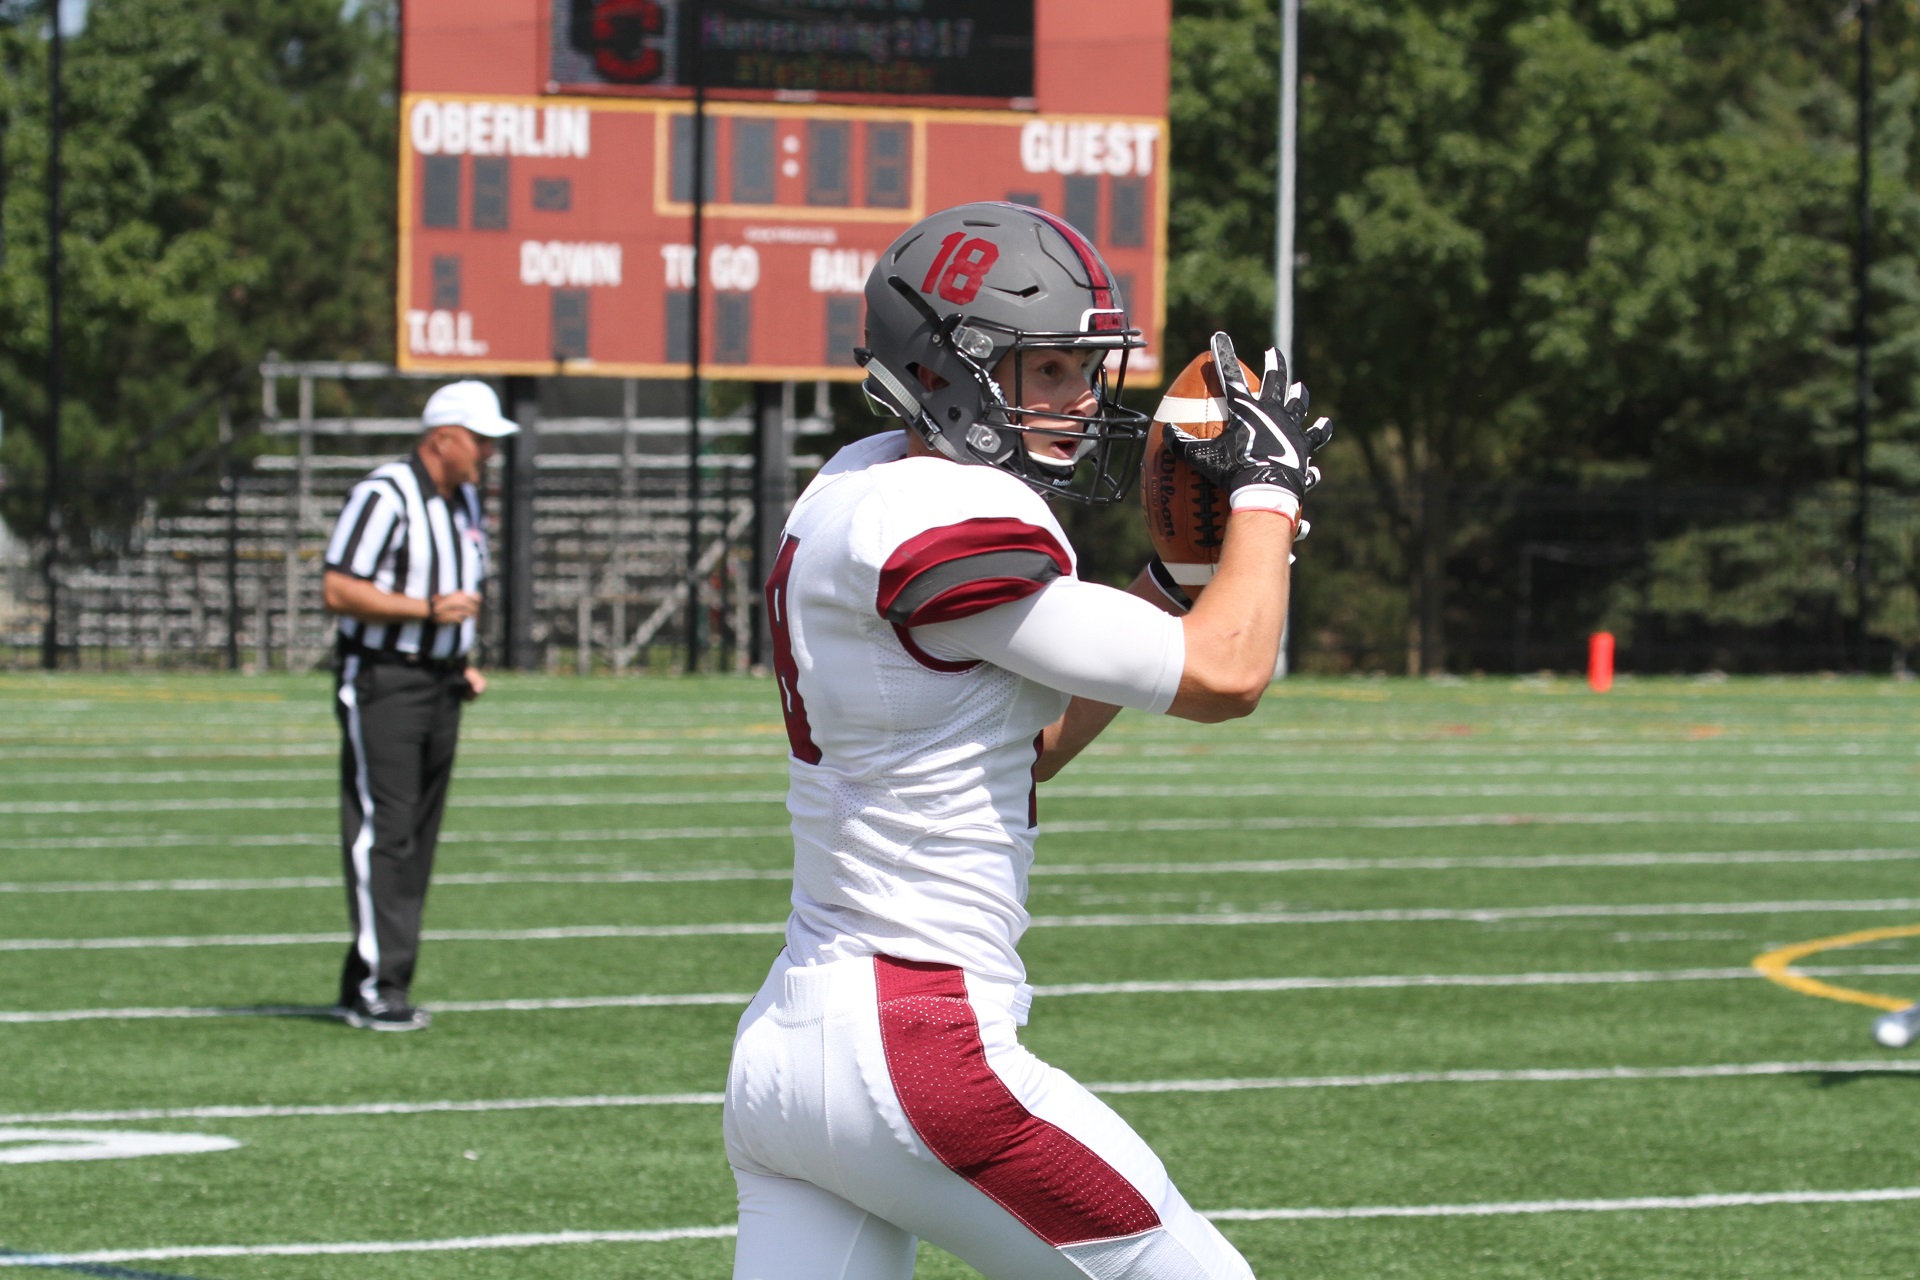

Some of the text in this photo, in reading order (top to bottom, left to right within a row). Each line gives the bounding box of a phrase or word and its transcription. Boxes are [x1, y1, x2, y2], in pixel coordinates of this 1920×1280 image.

[411, 100, 591, 158] OBERLIN
[1020, 119, 1159, 177] GUEST
[519, 240, 623, 287] DOWN
[709, 243, 761, 291] GO
[920, 231, 999, 306] 18
[1158, 448, 1176, 538] Wilson
